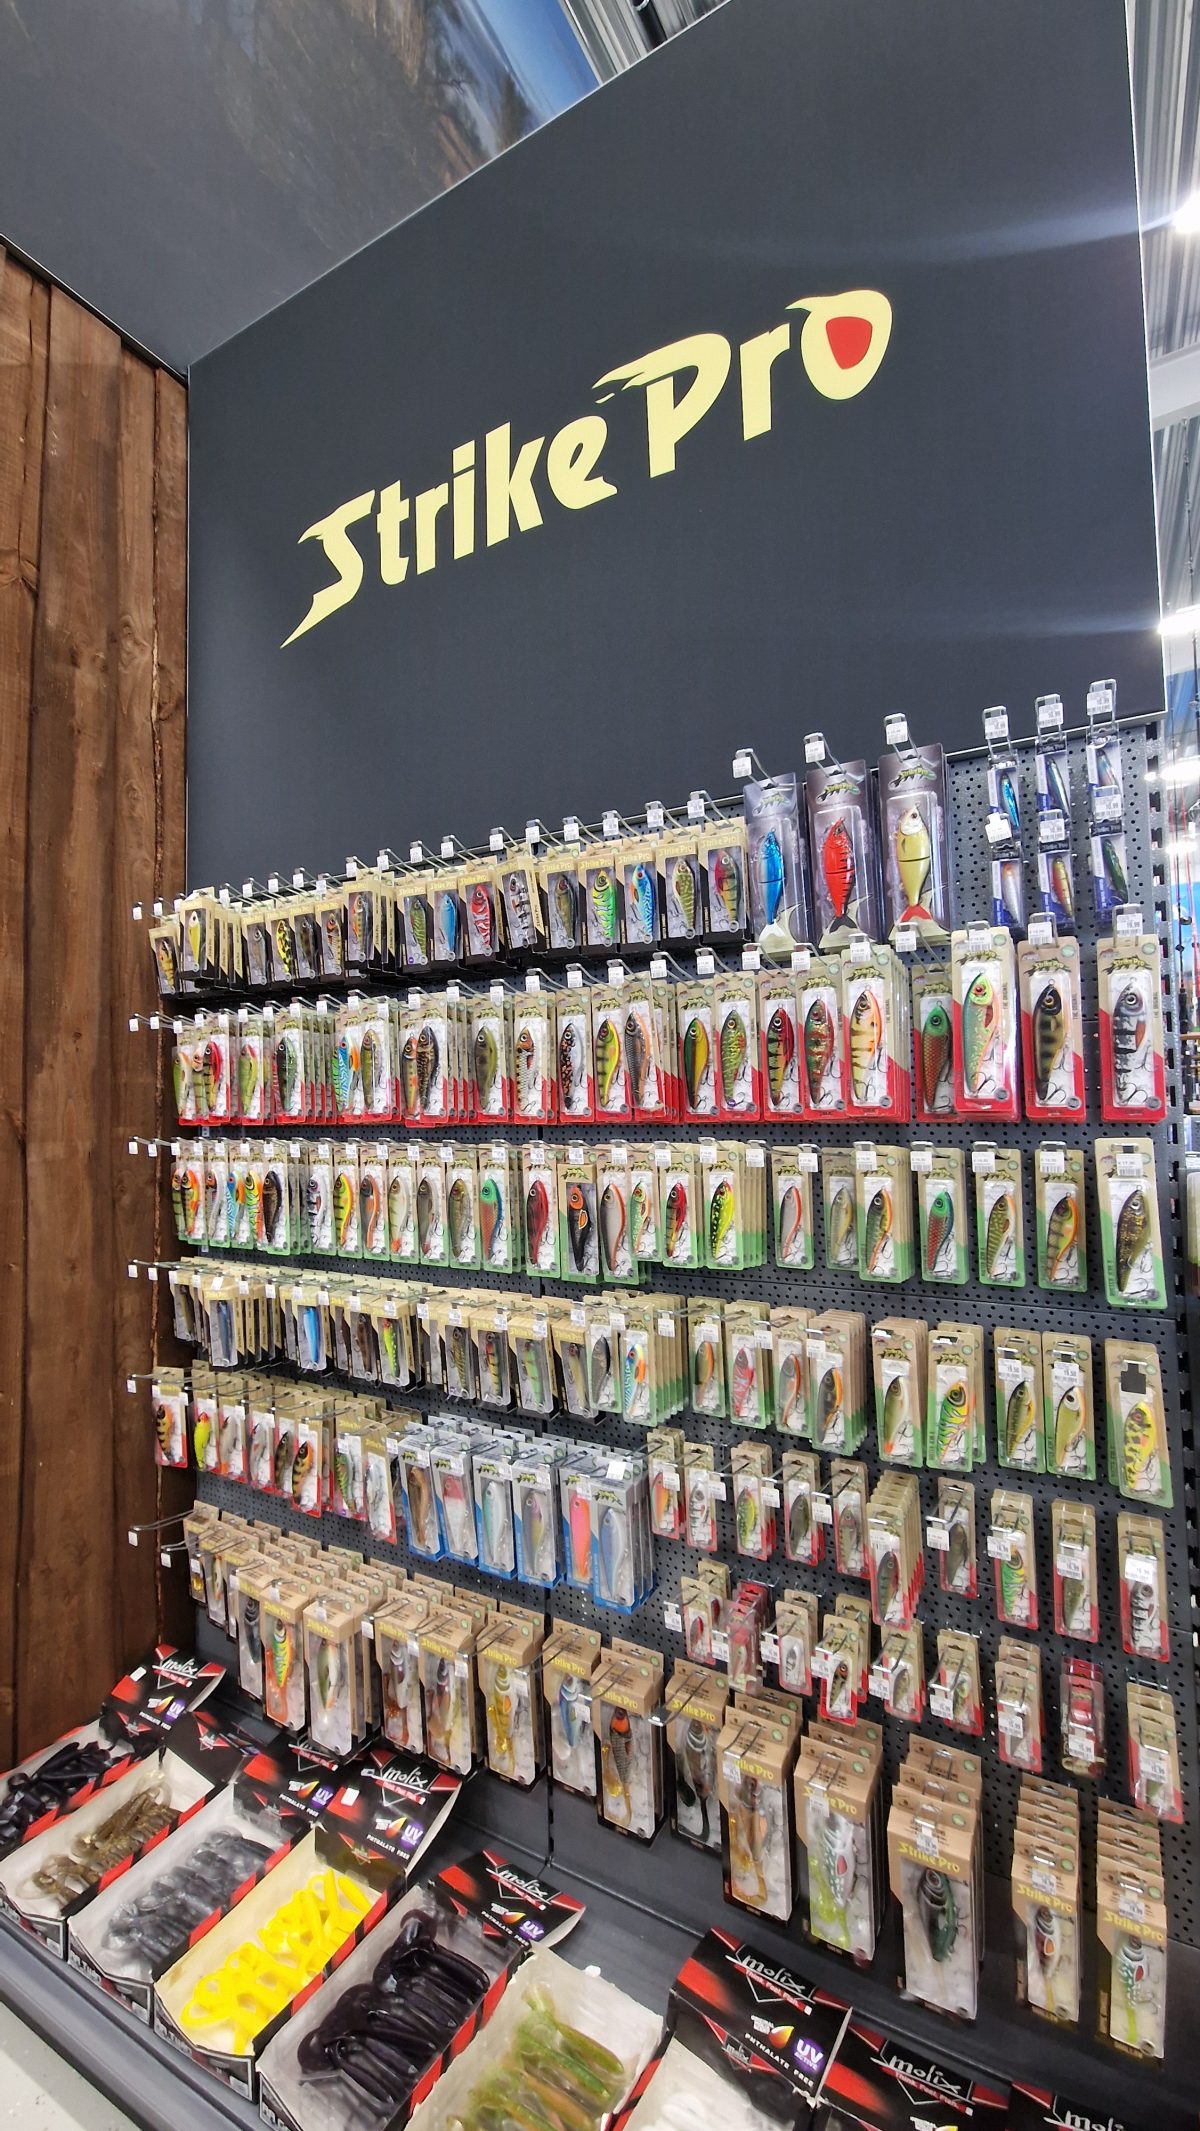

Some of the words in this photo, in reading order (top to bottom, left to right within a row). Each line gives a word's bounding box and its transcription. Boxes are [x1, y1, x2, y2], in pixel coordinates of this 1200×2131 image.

[280, 415, 618, 648] Strike
[592, 289, 893, 478] Pro
[754, 1764, 774, 1780] Pro
[403, 1824, 424, 1841] UV
[898, 1841, 936, 1866] Strike
[937, 1856, 961, 1874] Pro
[1017, 1883, 1051, 1904] Strike
[1051, 1896, 1073, 1912] Pro
[522, 1919, 545, 1937] UV
[1103, 1911, 1141, 1935] Strike
[1141, 1925, 1165, 1942] Pro
[795, 2038, 824, 2063] UV
